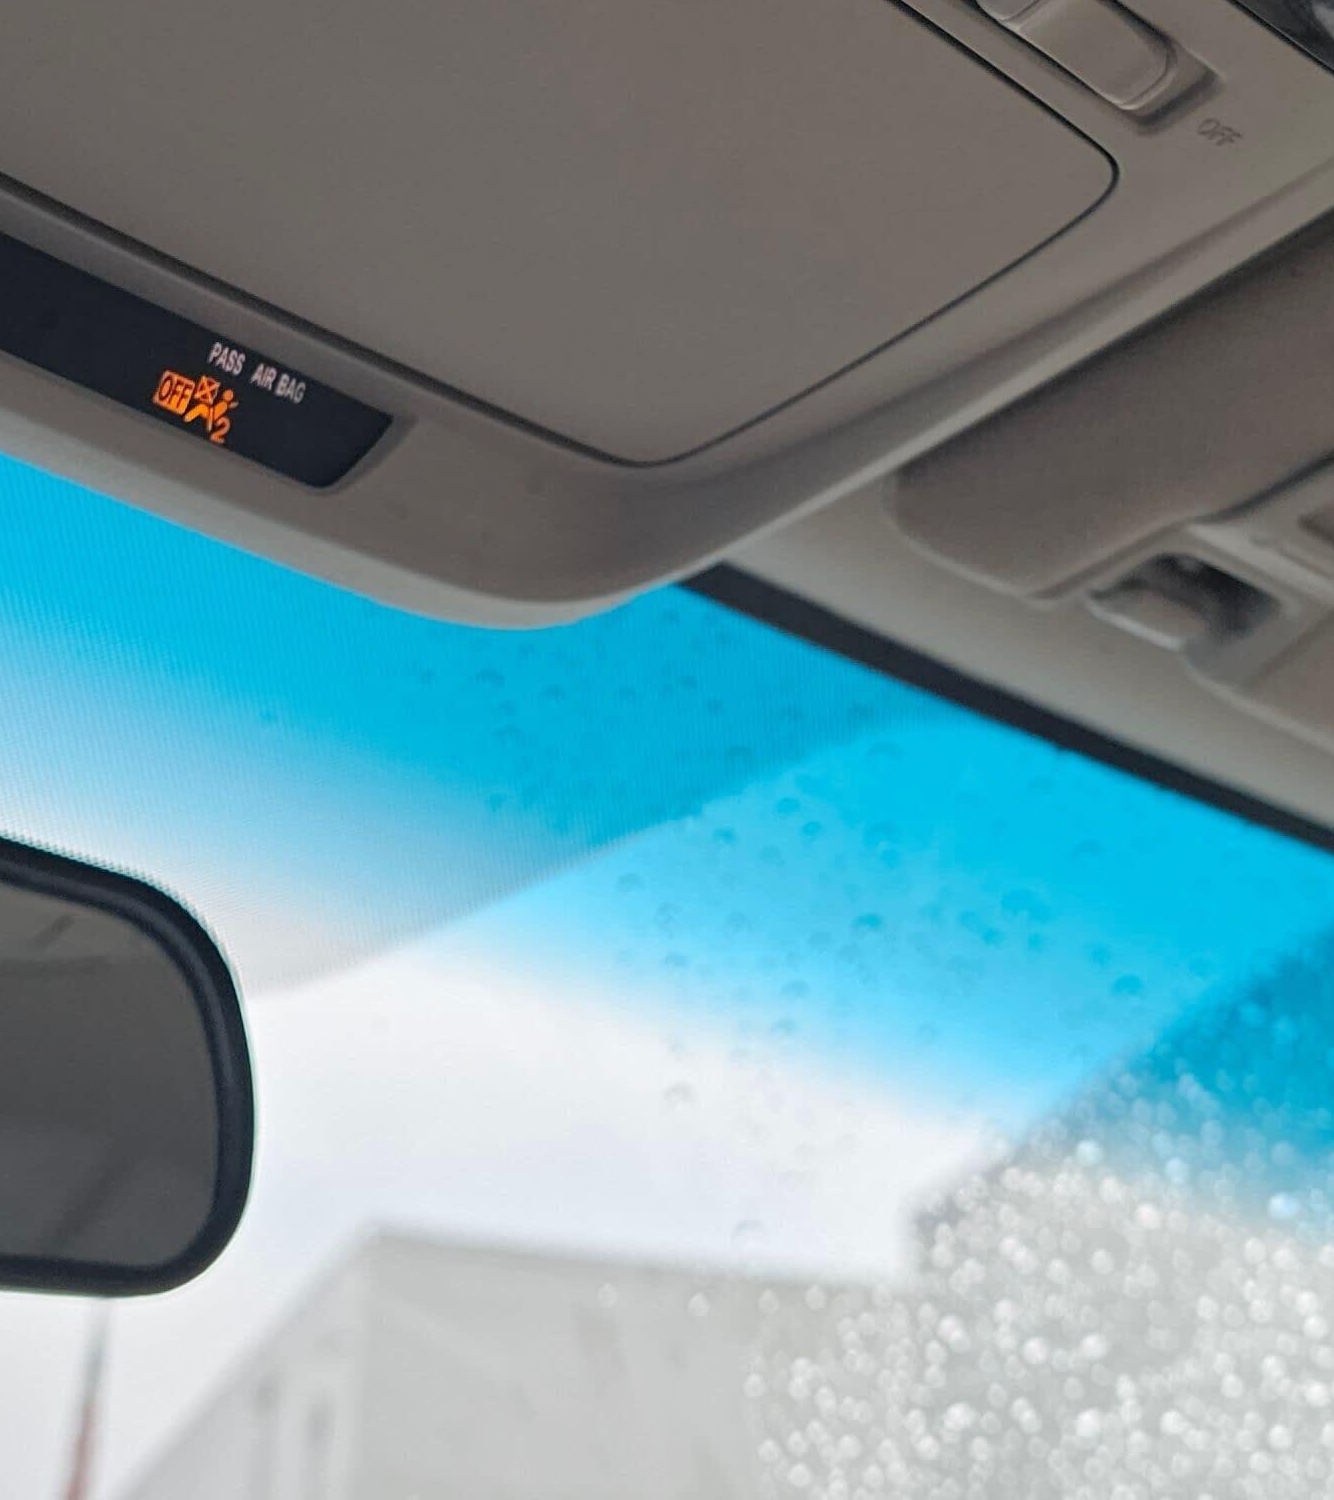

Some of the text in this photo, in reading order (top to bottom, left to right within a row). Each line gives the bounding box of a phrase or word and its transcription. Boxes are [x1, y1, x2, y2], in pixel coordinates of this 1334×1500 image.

[1196, 117, 1242, 147] OFF
[208, 342, 307, 403] PASS AIR BAG
[157, 373, 194, 408] OFF
